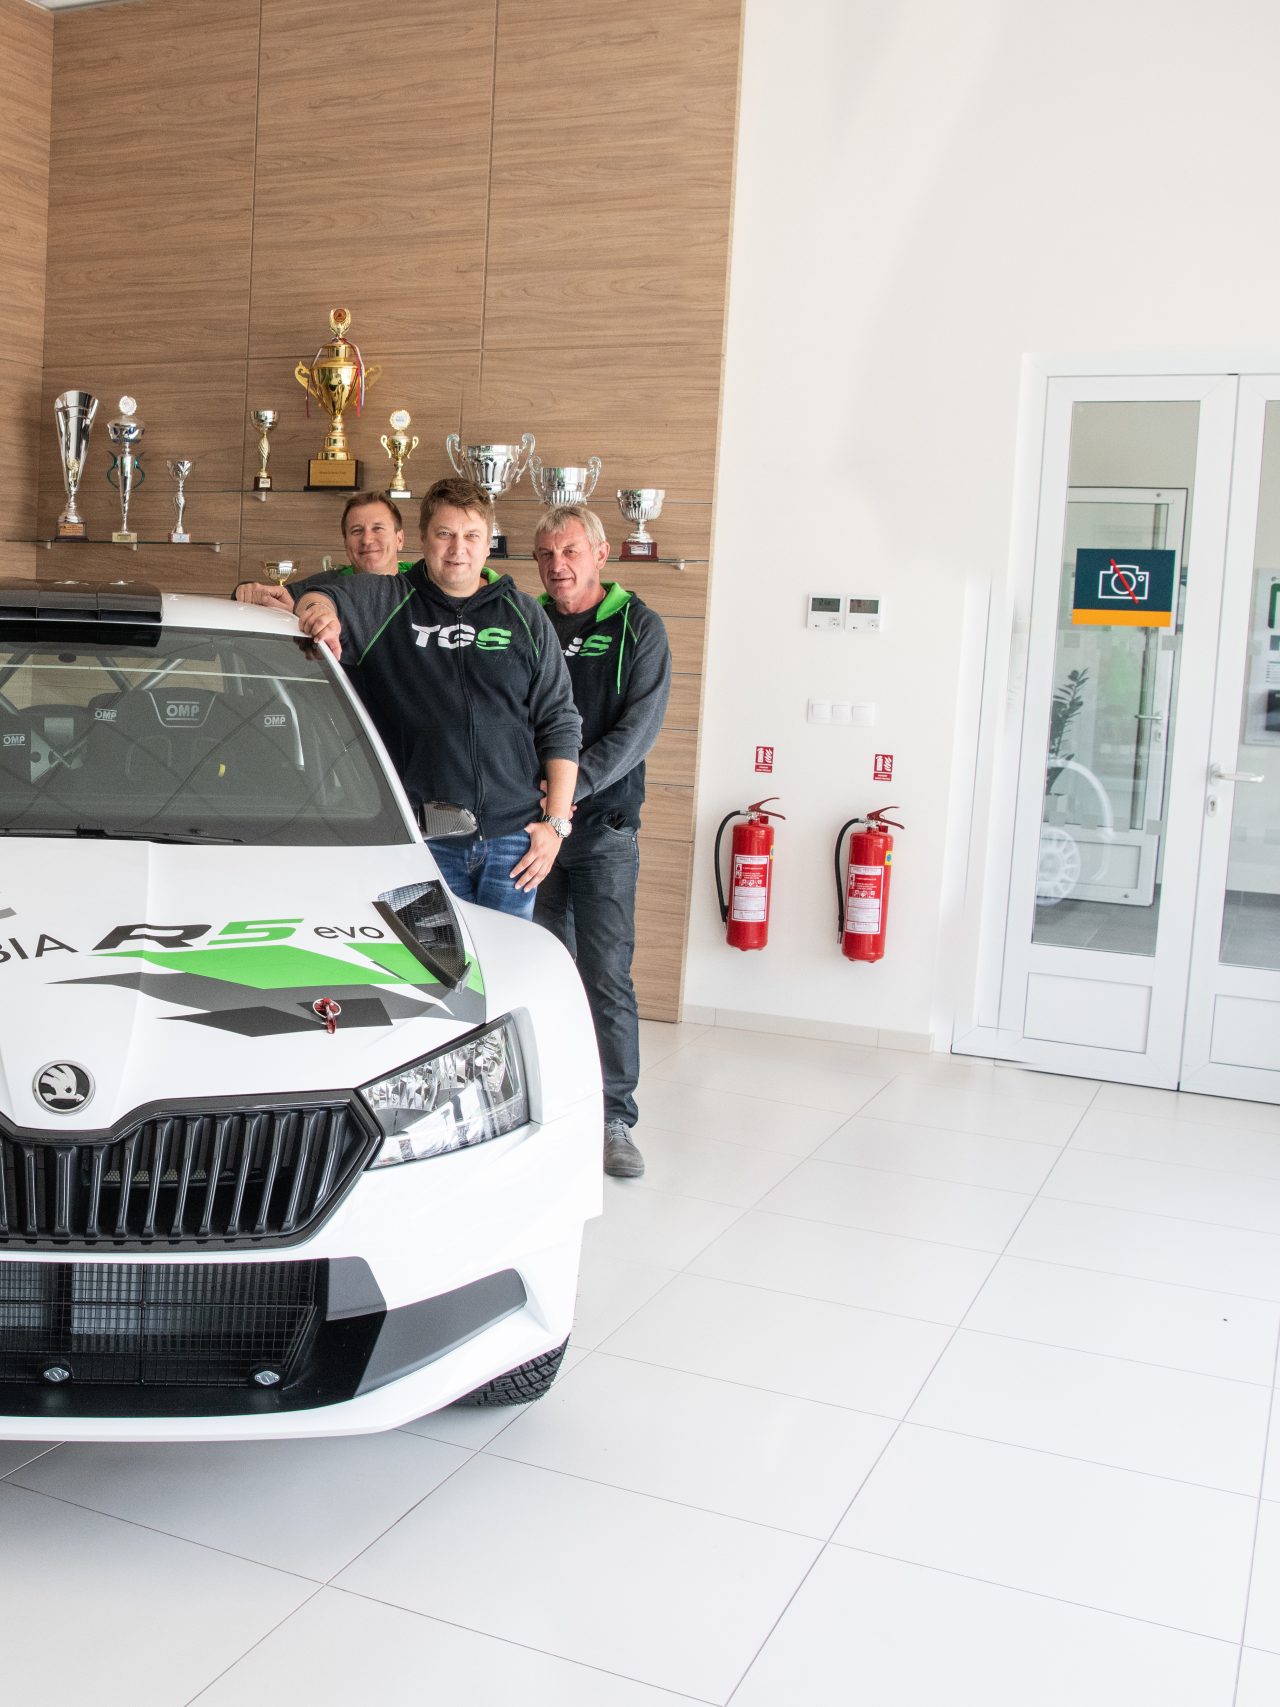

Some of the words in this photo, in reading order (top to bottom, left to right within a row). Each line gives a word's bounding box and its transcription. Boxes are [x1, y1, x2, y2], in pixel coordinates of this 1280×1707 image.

[411, 622, 512, 651] TGS
[94, 709, 118, 721] OMP
[166, 703, 200, 718] OMP
[263, 715, 286, 726] OMP
[3, 734, 26, 746] OMP
[92, 917, 306, 951] R5
[312, 921, 385, 943] evo
